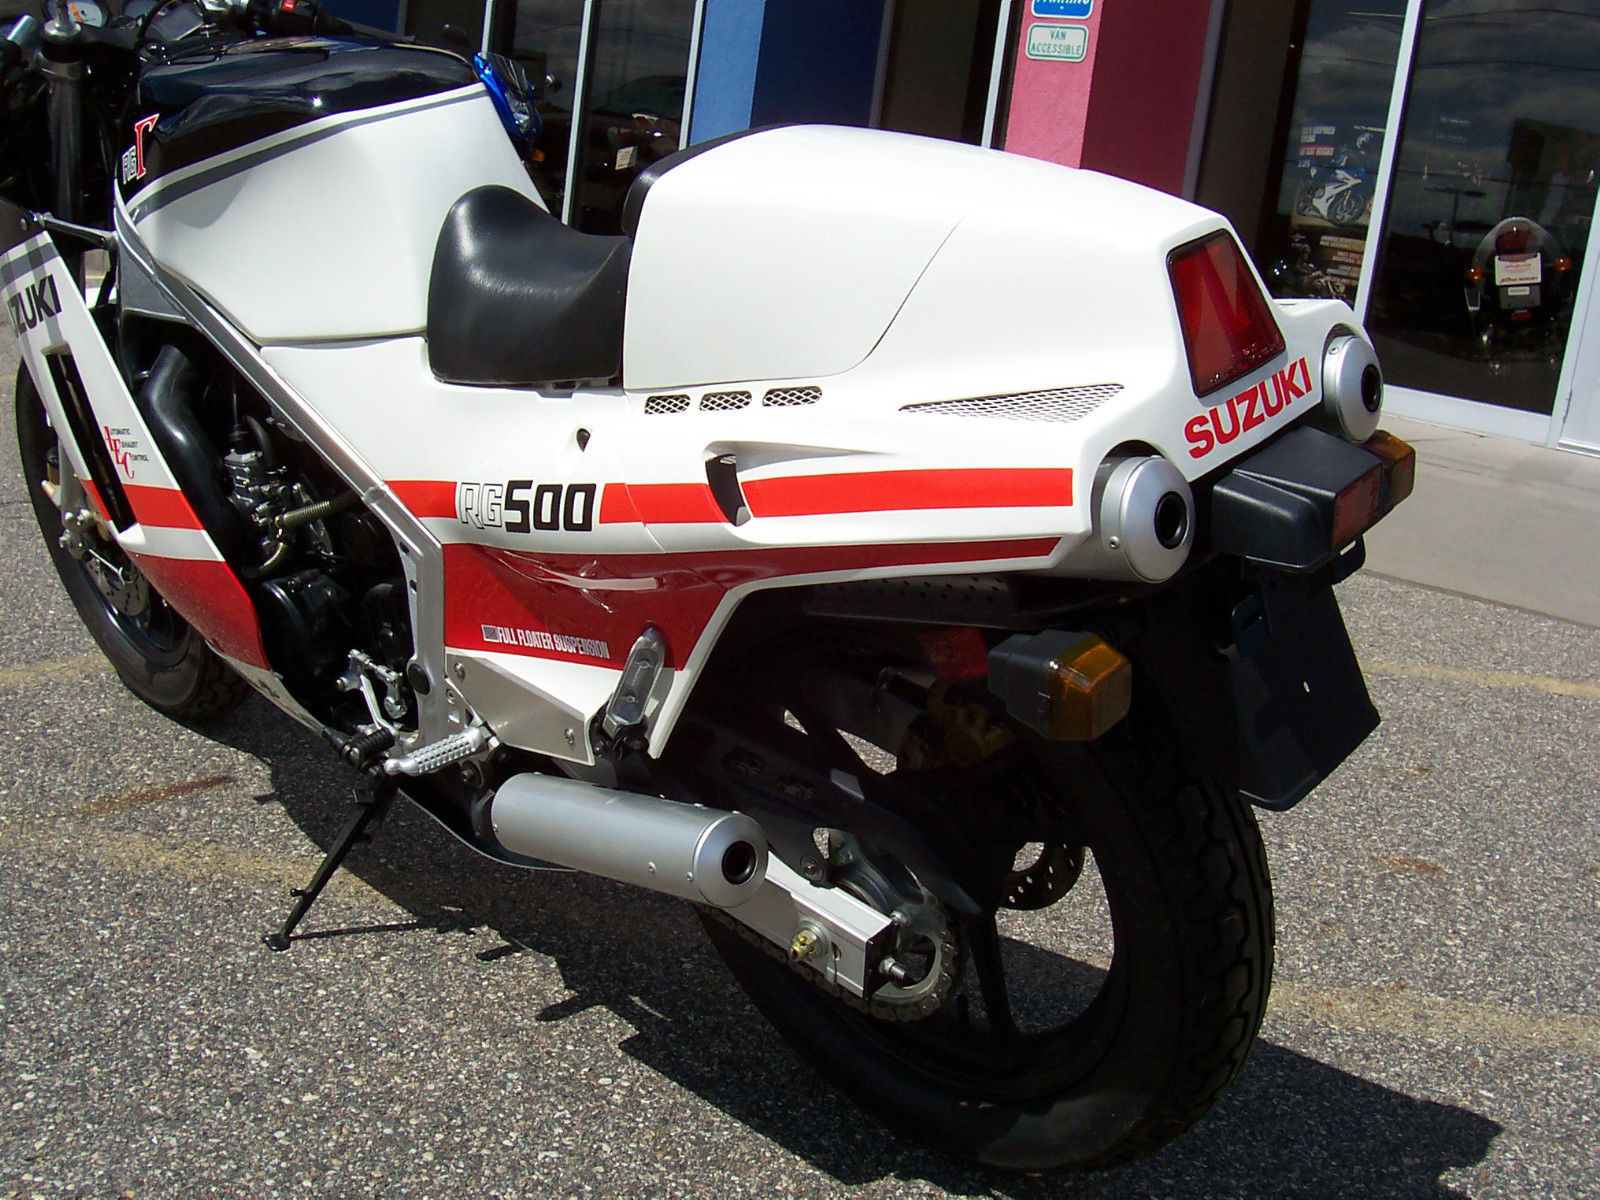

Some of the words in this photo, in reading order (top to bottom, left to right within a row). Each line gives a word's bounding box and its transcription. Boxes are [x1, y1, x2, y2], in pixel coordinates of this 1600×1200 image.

[1031, 43, 1082, 55] ACCESSIBLE
[1050, 30, 1067, 40] VAN
[7, 274, 62, 338] ZUKI
[1184, 356, 1313, 459] SUZUKI
[459, 480, 597, 533] RG500
[497, 626, 518, 645] FULL
[516, 628, 555, 651] FLOATER
[552, 633, 610, 659] SUSPENSION
